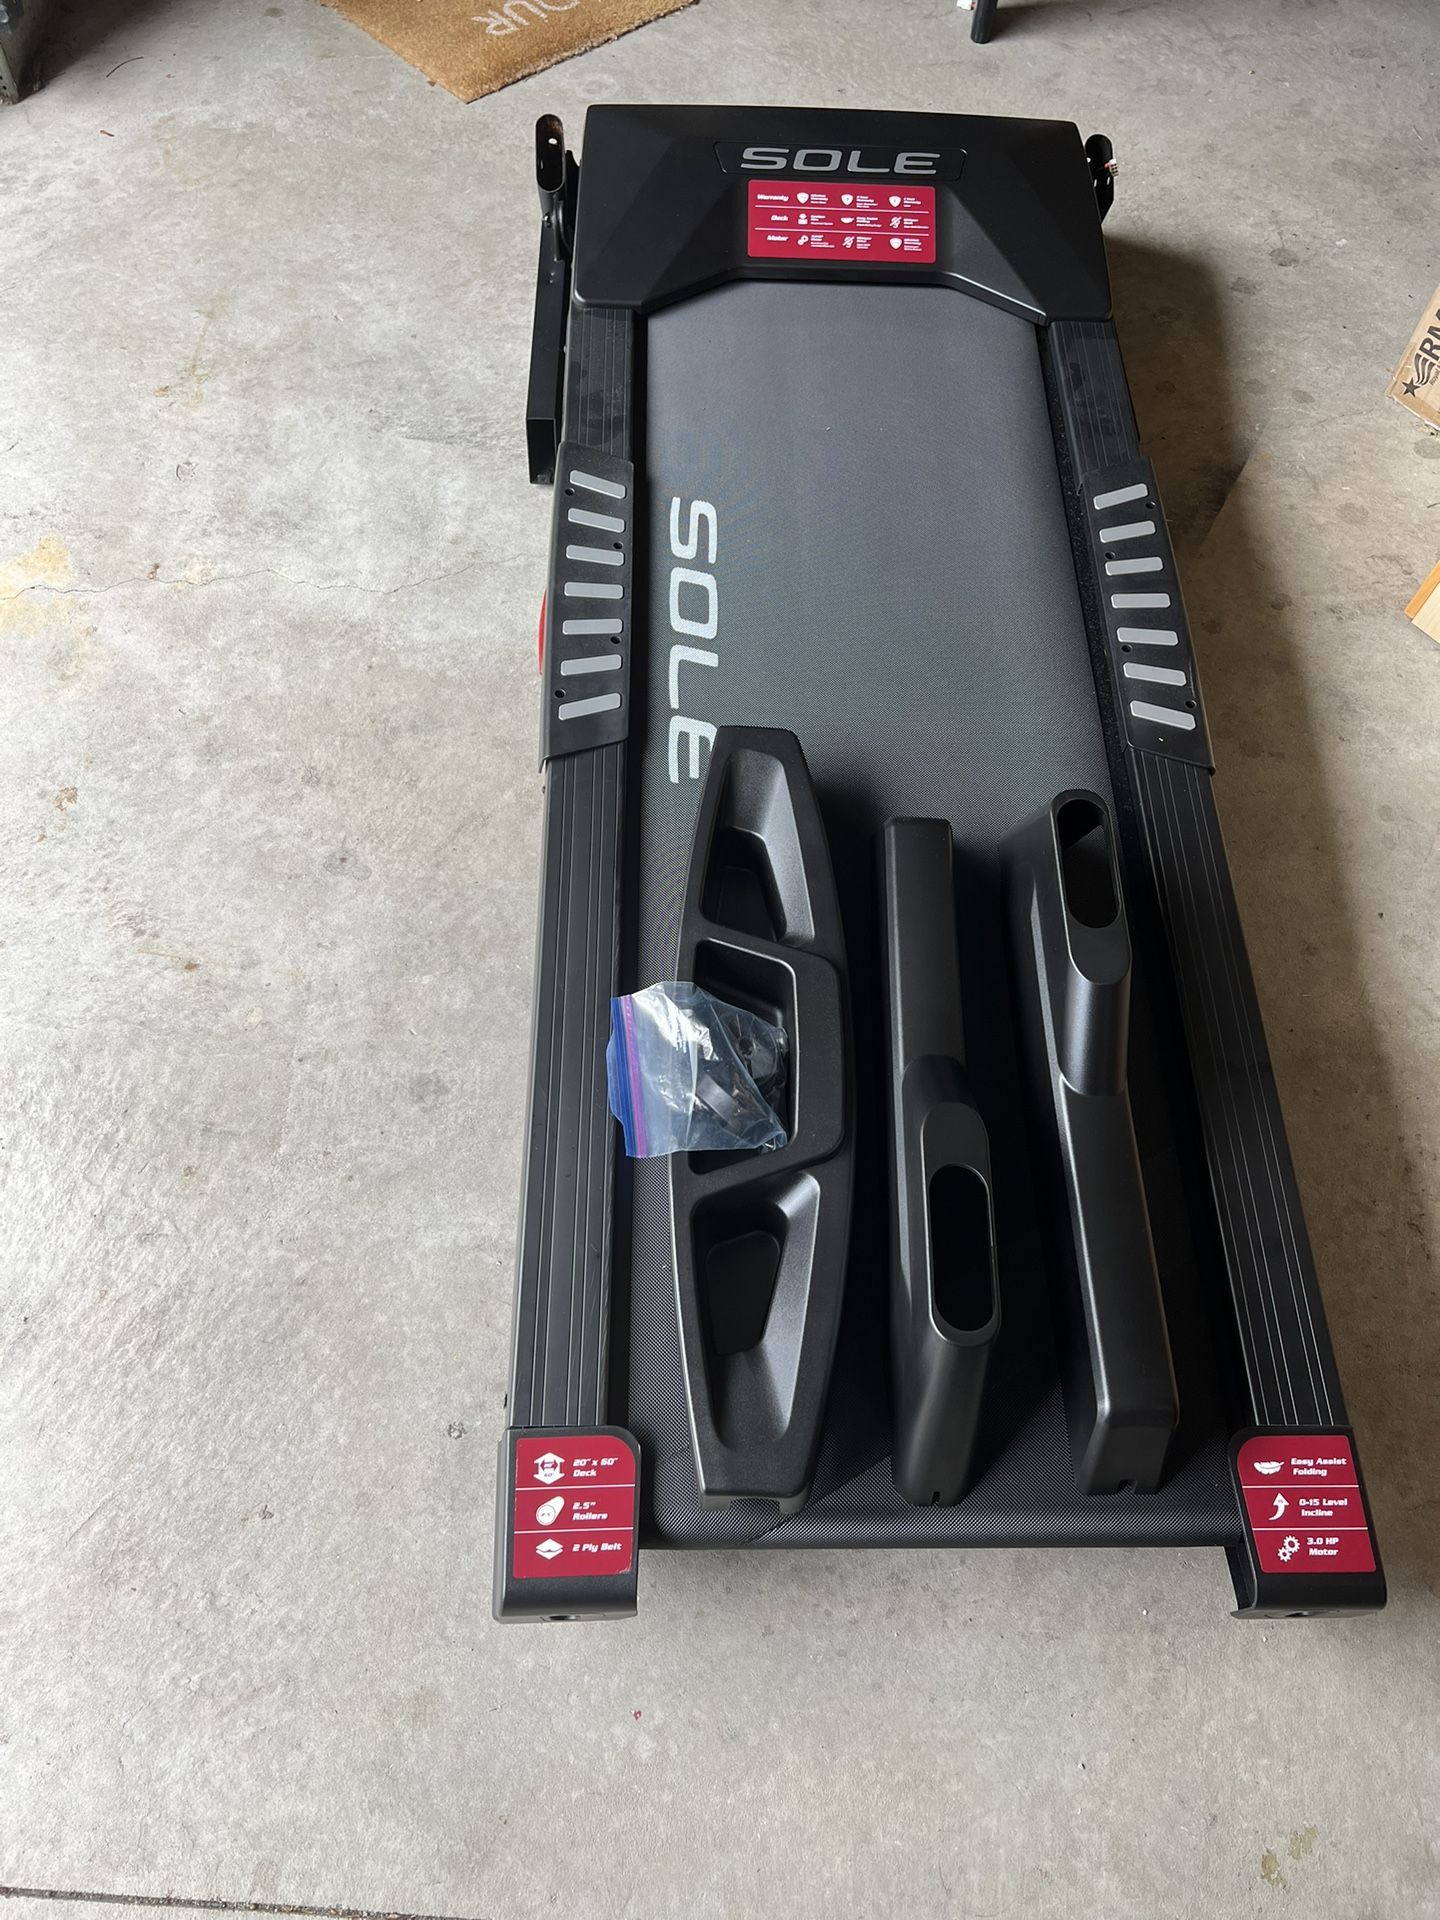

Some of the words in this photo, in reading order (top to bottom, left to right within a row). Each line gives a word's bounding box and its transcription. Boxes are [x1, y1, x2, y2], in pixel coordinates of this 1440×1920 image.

[741, 147, 940, 174] SOLE
[668, 497, 718, 783] SOLE
[1291, 1458, 1313, 1466] Easy
[573, 1469, 596, 1477] Deck
[1293, 1468, 1327, 1476] Folding
[572, 1544, 580, 1552] 2
[582, 1544, 598, 1552] Ply
[601, 1542, 622, 1551] Belt
[1309, 1548, 1338, 1556] Motor
